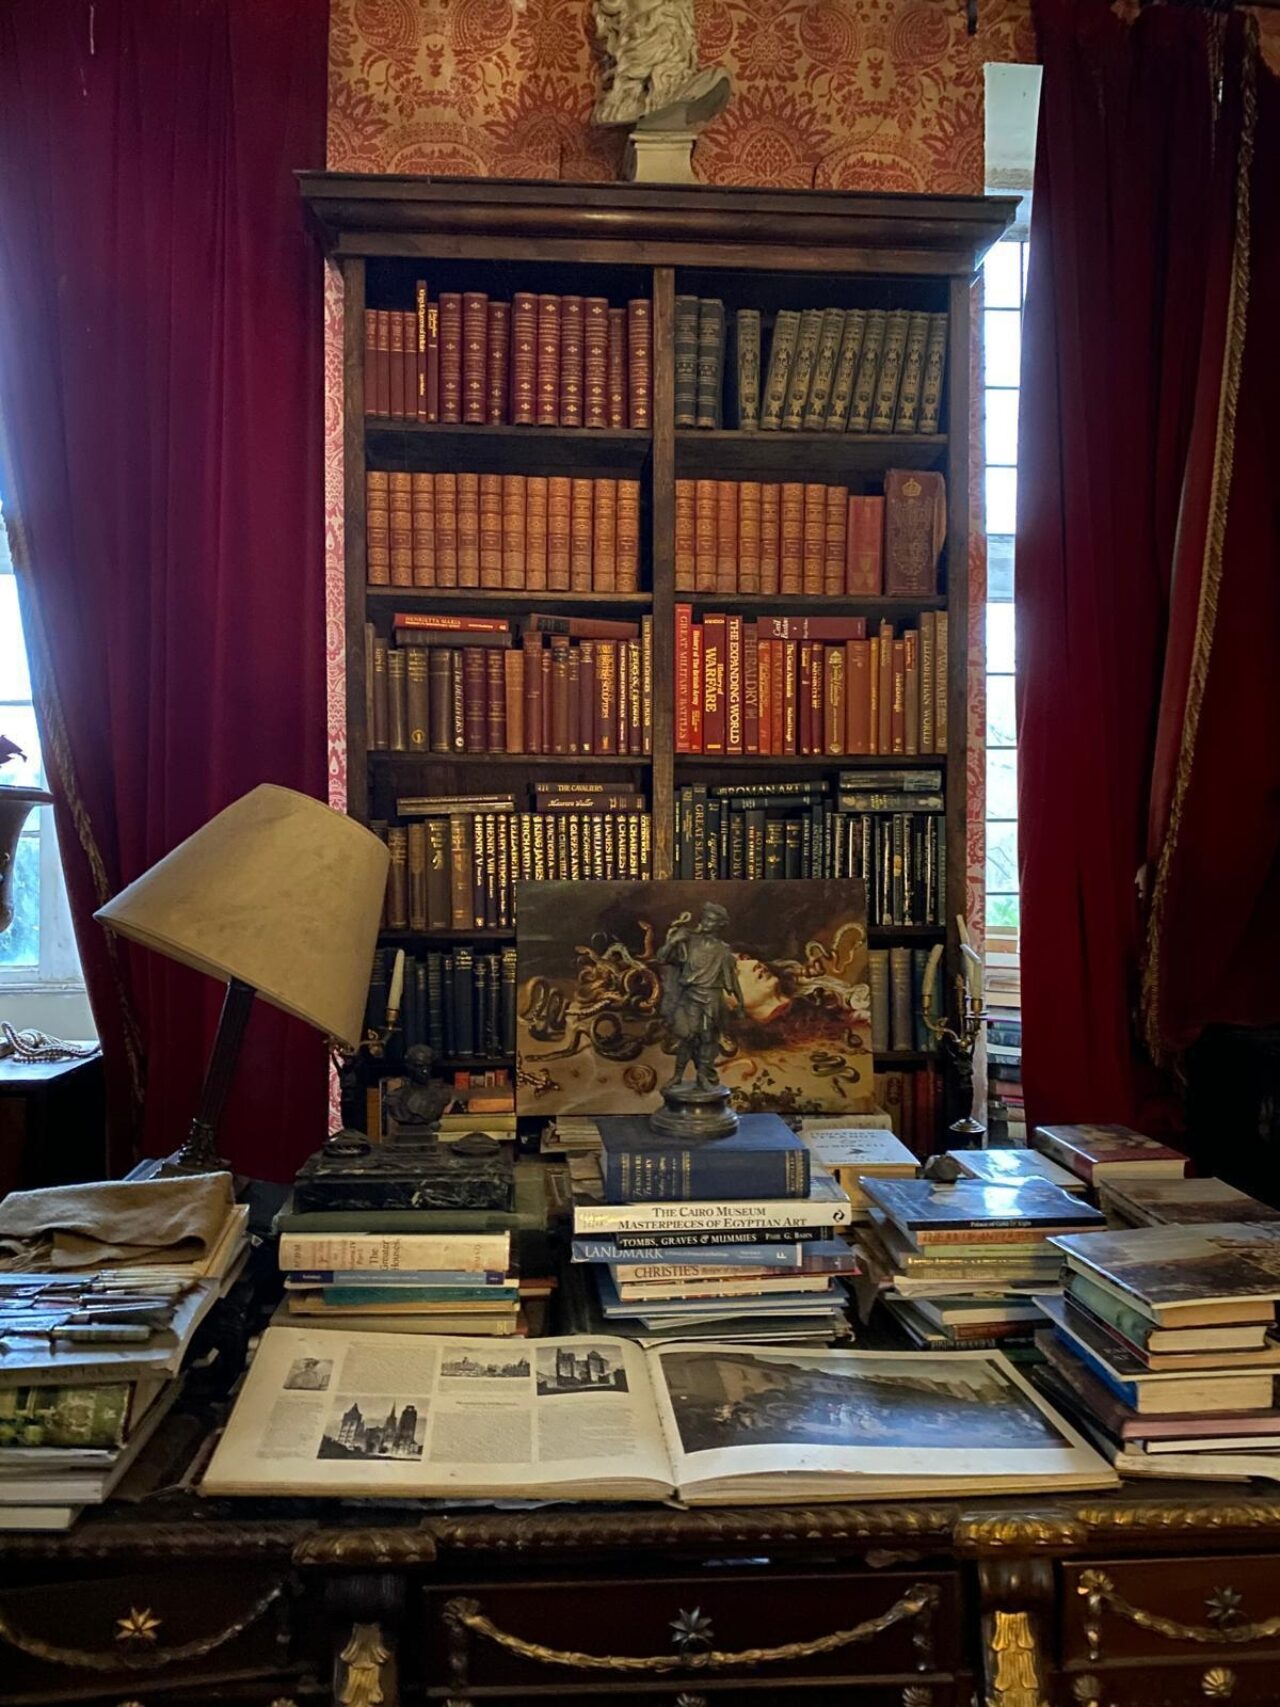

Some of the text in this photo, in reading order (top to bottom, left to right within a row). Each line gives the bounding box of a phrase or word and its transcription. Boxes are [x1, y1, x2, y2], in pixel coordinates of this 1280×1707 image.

[679, 616, 688, 739] GREAT MILITARY BATTLES
[705, 647, 717, 712] WARFARE
[716, 663, 724, 696] History of
[729, 619, 740, 744] THE EXPANDING WORLD
[744, 639, 758, 707] HERALDRY
[937, 655, 947, 706] WARFARE
[455, 684, 464, 733] DECEIVERS
[923, 640, 932, 745] ELIZABETHAN WORLD
[557, 784, 603, 792] THE CAVALIERS
[728, 783, 801, 795] ROMAN ART
[475, 823, 483, 856] HENRY
[498, 823, 507, 852] MARY
[511, 824, 519, 878] ELIZABETH
[522, 822, 531, 867] RICHARD
[534, 823, 544, 880] KING JAMES
[570, 824, 578, 856] QUEEN
[583, 824, 591, 864] GEORGE
[594, 824, 602, 877] WILLIAM IV
[605, 824, 613, 854] JAMES
[618, 824, 626, 869] CHARLES
[629, 824, 637, 868] CHARLES
[695, 804, 704, 880] GREAT SEA BAT
[498, 853, 507, 887] TUDOR
[733, 836, 743, 878] ARCHY
[749, 865, 755, 874] OF
[755, 856, 763, 880] STRO
[618, 1217, 808, 1230] MASTERPIECES OF EGYPTIAN ART
[652, 1207, 766, 1217] THE CAIRO MUSEUM
[369, 1248, 378, 1264] The
[379, 1240, 389, 1271] Greater
[390, 1240, 400, 1271] Houses
[585, 1245, 663, 1259] LANDMARK
[622, 1238, 659, 1248] TOMBS,
[661, 1236, 697, 1245] GRAVES
[699, 1235, 709, 1244] &
[711, 1233, 757, 1243] MUMMIES
[635, 1266, 699, 1278] CHRISTIE'S
